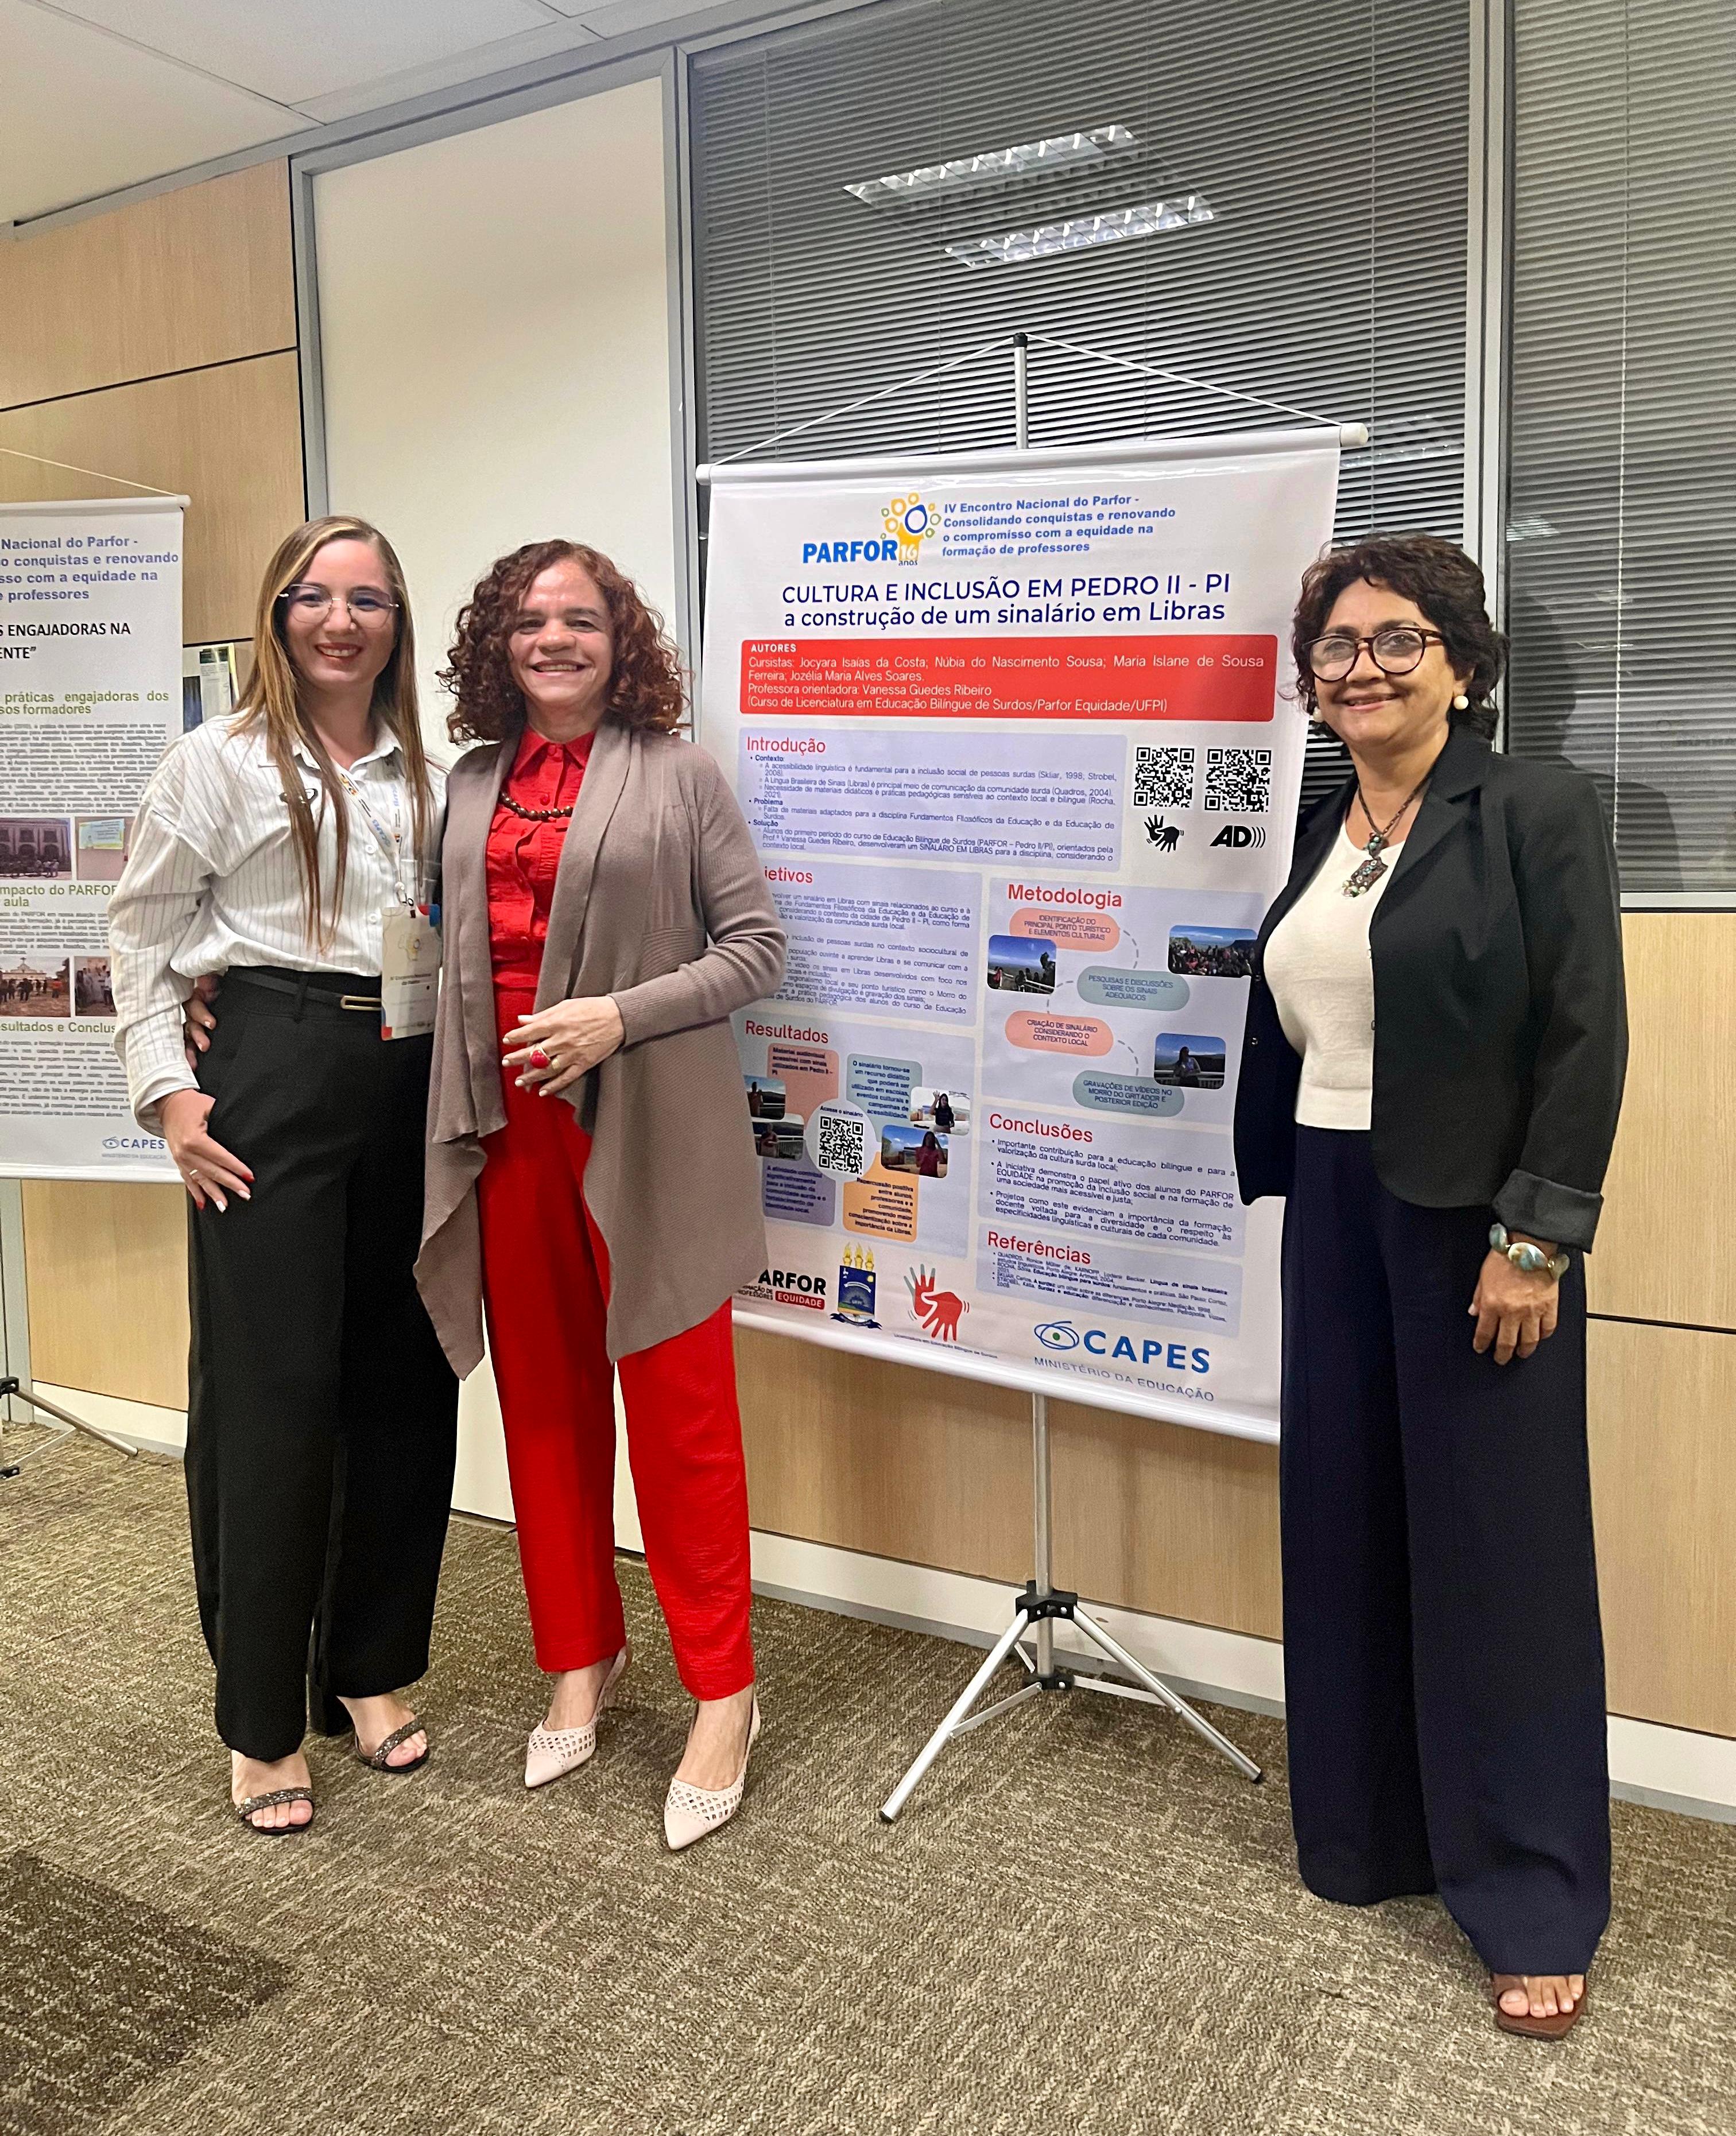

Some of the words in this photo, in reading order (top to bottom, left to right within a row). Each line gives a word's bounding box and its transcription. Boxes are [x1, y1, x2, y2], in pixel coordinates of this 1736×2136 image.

[944, 504, 956, 513] IV
[960, 502, 1012, 513] Encontro
[1017, 498, 1070, 510] Nacional
[1074, 497, 1088, 506] do
[1093, 495, 1132, 506] Parfor
[944, 516, 1021, 528] Consolidando
[1026, 512, 1092, 525] conquistas
[1109, 508, 1176, 520] renovando
[954, 530, 1031, 543] compromisso
[1036, 529, 1061, 538] com
[1065, 529, 1072, 537] a
[1077, 525, 1134, 538] equidade
[1138, 525, 1153, 534] na
[2, 538, 61, 549] Nacional
[66, 537, 83, 548] do
[87, 536, 130, 546] Parfor
[803, 540, 898, 563] PARFOR
[942, 546, 995, 557] formação
[1000, 545, 1014, 554] de
[1018, 542, 1090, 556] professores
[14, 555, 88, 568] conquistas
[106, 552, 179, 564] renovando
[27, 575, 55, 583] com
[60, 574, 67, 582] a
[73, 571, 136, 584] equidade
[141, 572, 157, 580] na
[783, 584, 879, 604] CULTURA
[886, 583, 896, 600] E
[906, 576, 1020, 600] INCLUSÃO
[1028, 579, 1063, 598] EM
[1071, 575, 1159, 596] PEDRO
[1167, 576, 1180, 593] II
[1206, 574, 1230, 593] PI
[9, 590, 89, 603] professores
[785, 612, 795, 626] a
[801, 606, 914, 630] construção
[922, 604, 947, 625] de
[956, 608, 990, 623] um
[998, 602, 1095, 623] sinalário
[1103, 606, 1140, 621] em
[1150, 600, 1226, 621] Libras
[9, 623, 106, 636] ENGAJADORAS
[111, 623, 131, 635] NA
[751, 643, 796, 652] AUTORES
[799, 657, 836, 671] Jocyara
[842, 657, 870, 668] Isaías
[876, 657, 889, 668] da
[894, 657, 928, 669] Costa;
[935, 656, 965, 667] Núbia
[971, 657, 986, 667] do
[993, 655, 1059, 668] Nascimento
[1067, 656, 1106, 668] Sousa;
[1114, 655, 1145, 667] Maria
[1153, 655, 1189, 666] Islane
[1198, 655, 1214, 666] de
[1222, 654, 1264, 667] Sousa
[789, 670, 822, 681] Jozélia
[825, 670, 851, 681] Maria
[854, 670, 882, 681] Alves
[749, 684, 799, 695] Professora
[863, 685, 906, 695] Vanessa
[909, 684, 951, 696] Guedes
[955, 685, 991, 696] Ribeiro
[5, 692, 54, 704] práticas
[65, 691, 139, 704] engajadoras
[147, 691, 169, 701] dos
[23, 704, 91, 714] formadores
[748, 696, 778, 708] (Curso
[781, 696, 793, 707] de
[796, 696, 854, 708] Licenciatura
[857, 700, 873, 708] em
[875, 697, 927, 711] Educação
[930, 699, 971, 712] Bilíngue
[975, 699, 990, 710] de
[993, 699, 1071, 711] Surdos/Parfor
[1075, 699, 1167, 713] Equidade/UFPI)
[747, 736, 826, 755] Introdução
[50, 885, 64, 894] do
[4, 897, 29, 906] aula
[1009, 885, 1121, 909] Metodologia
[1034, 929, 1070, 937] ELEMENTOS
[1072, 932, 1105, 940] CULTURAIS
[1089, 975, 1123, 984] PESQUISAS
[1106, 992, 1146, 1001] ADEQUADOS
[1027, 1019, 1054, 1028] CRIAÇÃO
[746, 1021, 828, 1044] Resultados
[1033, 1034, 1067, 1043] CONTEXTO
[1034, 1028, 1083, 1038] CONSIDERANDO
[1088, 1088, 1111, 1096] MORRO
[1125, 1092, 1159, 1101] GRITADOR
[1095, 1096, 1130, 1106] POSTERIOR
[990, 1114, 1092, 1142] Conclusões
[121, 1139, 165, 1149] CAPES
[998, 1139, 1036, 1150] Importante
[1040, 1146, 1083, 1157] contribuição
[1088, 1153, 1103, 1161] para
[1118, 1158, 1156, 1168] educação
[988, 1231, 1090, 1265] Referências
[778, 1293, 822, 1307] EQUIDADE
[1084, 1330, 1210, 1373] CAPES
[1034, 1357, 1110, 1378] MINISTÉRIO
[1115, 1373, 1133, 1383] DA
[1138, 1378, 1214, 1401] EDUCAÇÃO
